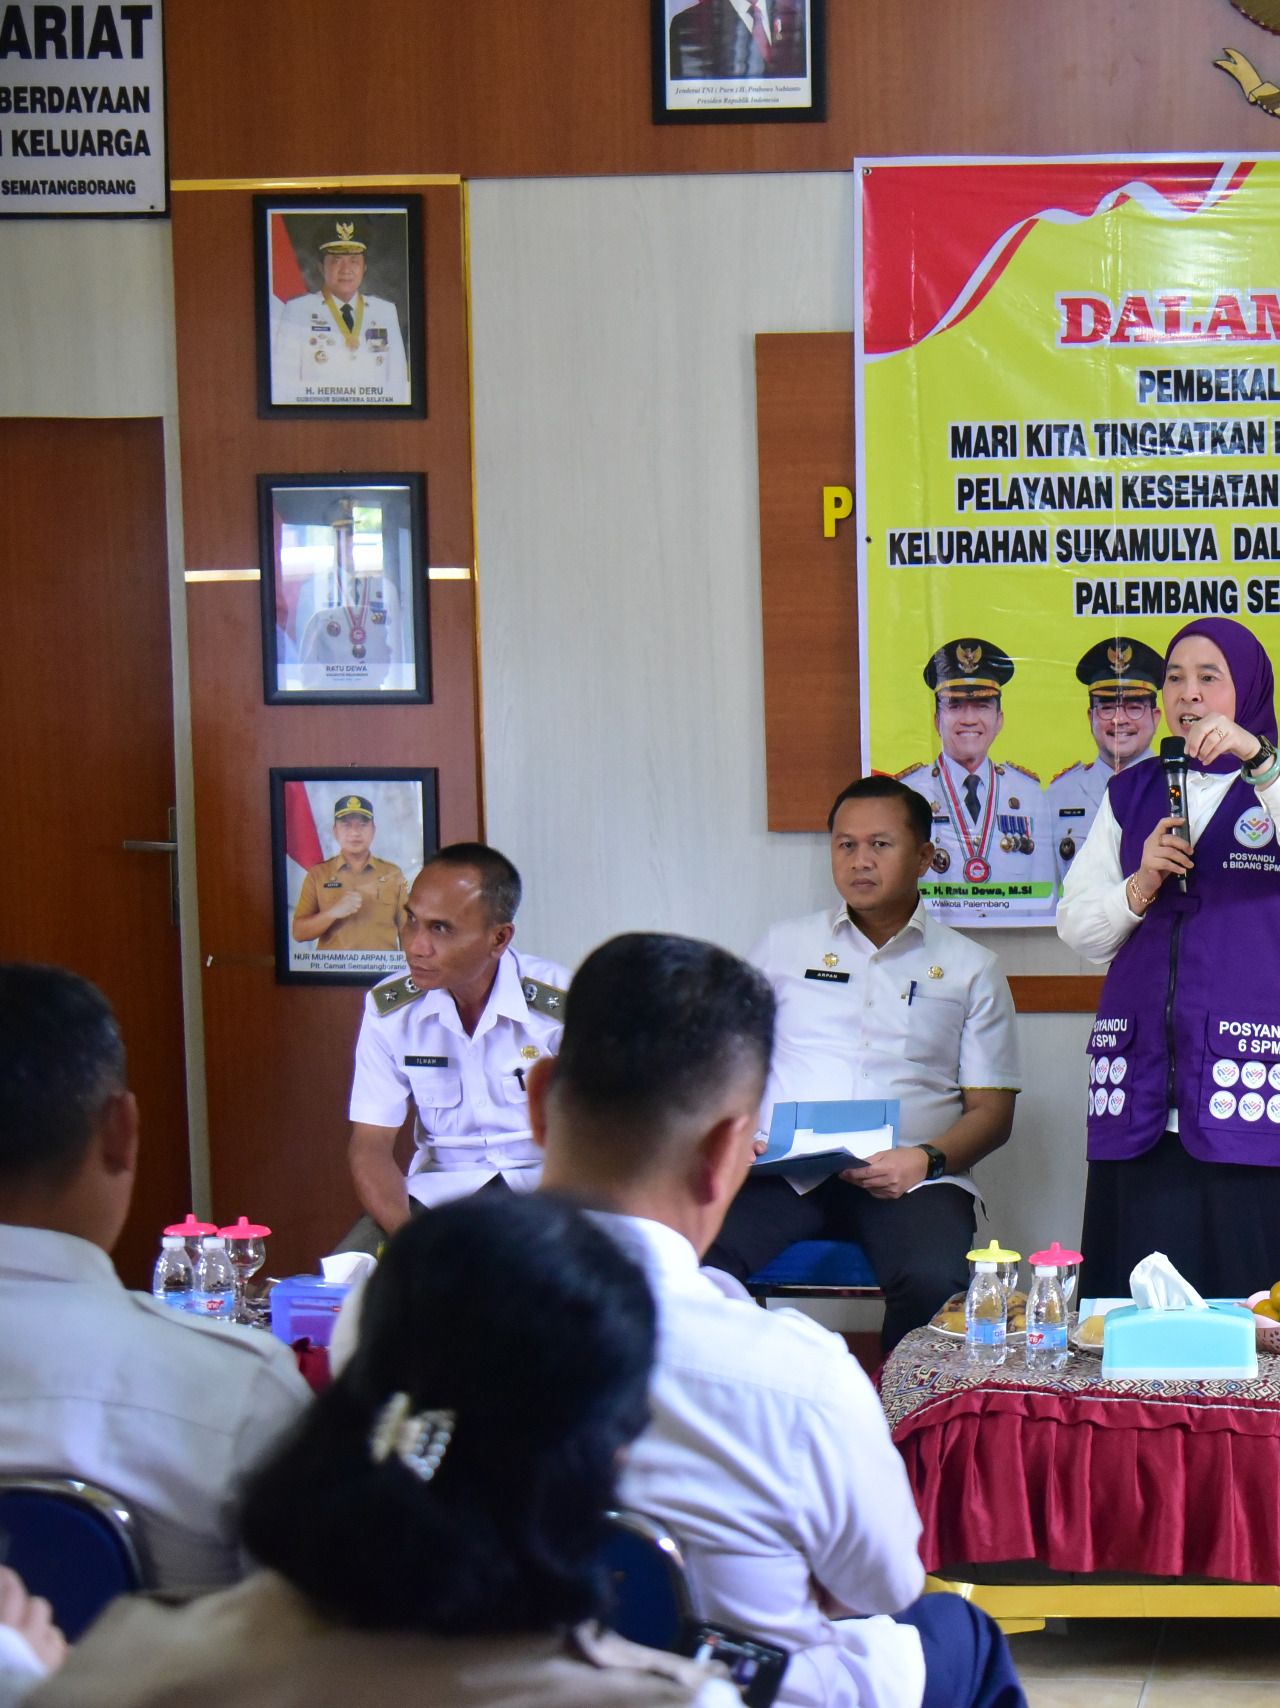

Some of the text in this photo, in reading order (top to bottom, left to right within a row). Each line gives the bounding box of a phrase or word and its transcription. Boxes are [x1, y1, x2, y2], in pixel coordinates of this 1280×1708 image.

[0, 5, 152, 59] ARIAT
[0, 86, 150, 113] BERDAYAAN
[12, 129, 151, 157] KELUARGA
[1, 179, 136, 195] SEMATANGBORANG
[305, 387, 384, 395] H. HERMAN DERU
[951, 425, 1017, 458] MARI
[1026, 424, 1084, 457] KITA
[1094, 421, 1265, 456] TINGKATKAN
[957, 476, 1113, 510] PELAYANAN
[1122, 473, 1279, 508] KESEHATAN
[889, 531, 1047, 565] KELURAHAN
[1056, 528, 1217, 563] SUKAMULYA
[1076, 582, 1238, 615] PALEMBANG
[1222, 861, 1228, 869] 6
[1230, 861, 1262, 870] BIDANG
[1229, 853, 1276, 863] POSYANDU
[933, 886, 943, 895] H.
[932, 900, 1010, 909] Walikota Palembang
[294, 953, 310, 961] NUR
[312, 953, 359, 961] MUHAMMAD
[361, 953, 388, 962] ARPAN,
[1096, 1034, 1117, 1048] SPM
[1238, 1038, 1247, 1052] 6
